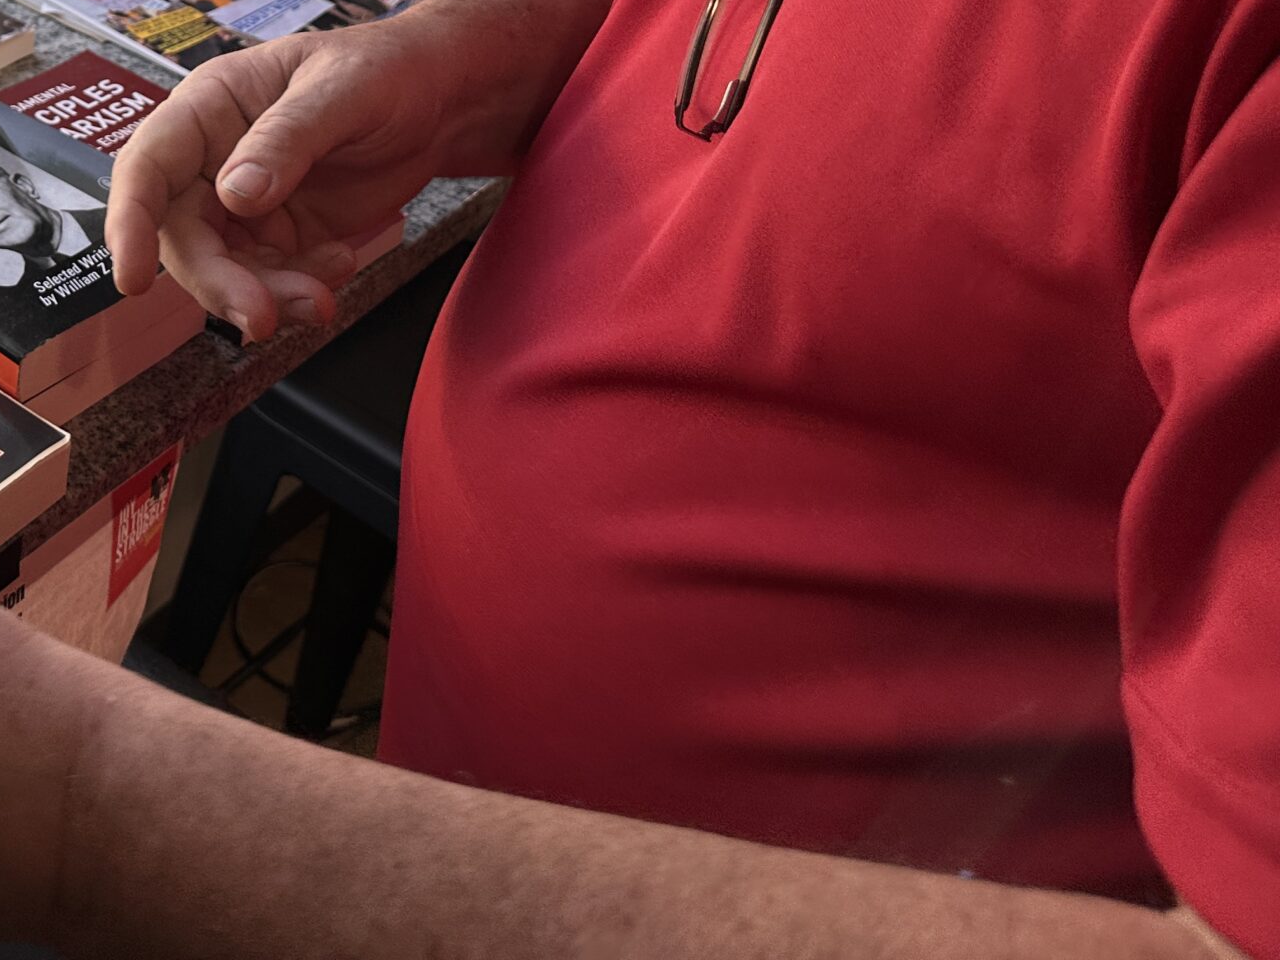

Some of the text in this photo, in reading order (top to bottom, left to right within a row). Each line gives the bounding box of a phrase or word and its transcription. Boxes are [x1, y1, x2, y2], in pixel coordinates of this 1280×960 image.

[34, 79, 124, 125] CIPLES
[33, 245, 113, 293] Selected Writi
[39, 293, 58, 307] by
[53, 270, 101, 298] William
